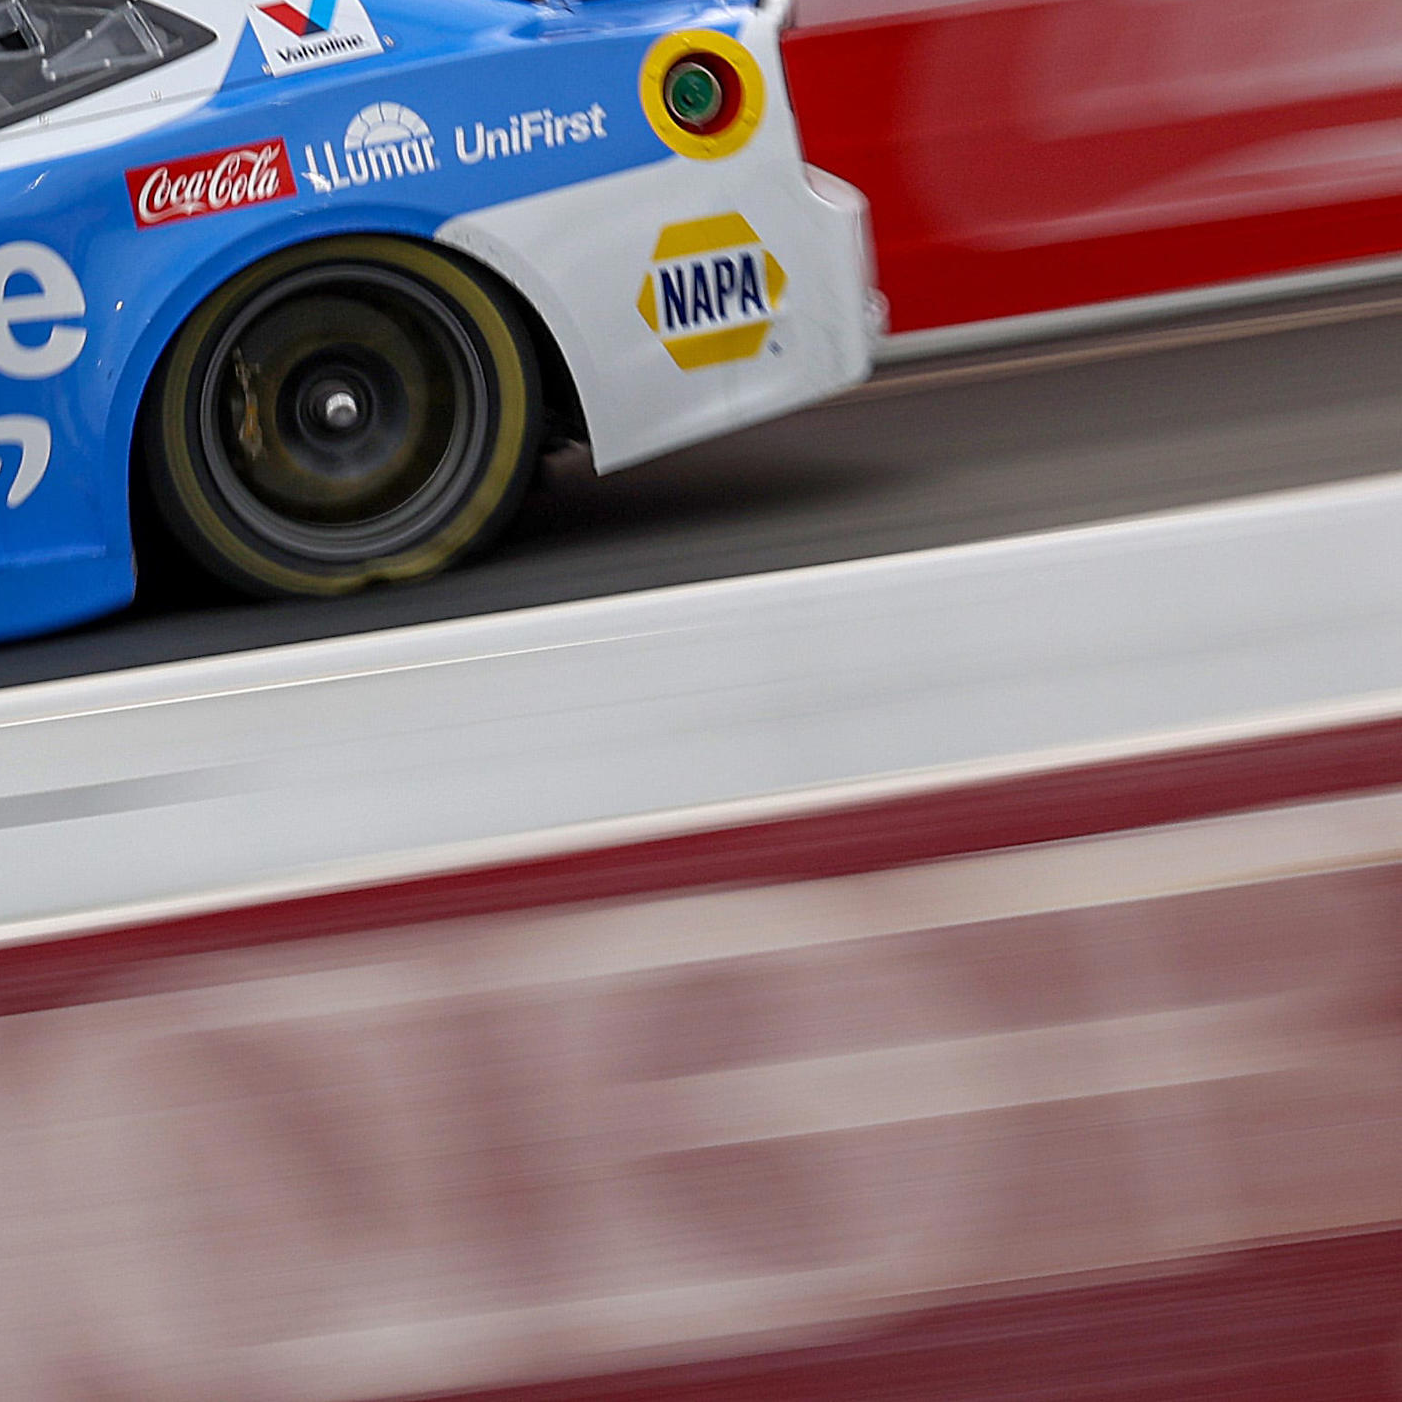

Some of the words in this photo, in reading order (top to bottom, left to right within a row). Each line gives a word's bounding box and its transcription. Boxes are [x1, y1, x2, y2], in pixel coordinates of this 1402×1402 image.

[277, 34, 366, 63] Valvoline
[454, 101, 608, 165] UniFirst
[659, 251, 769, 333] NAPA
